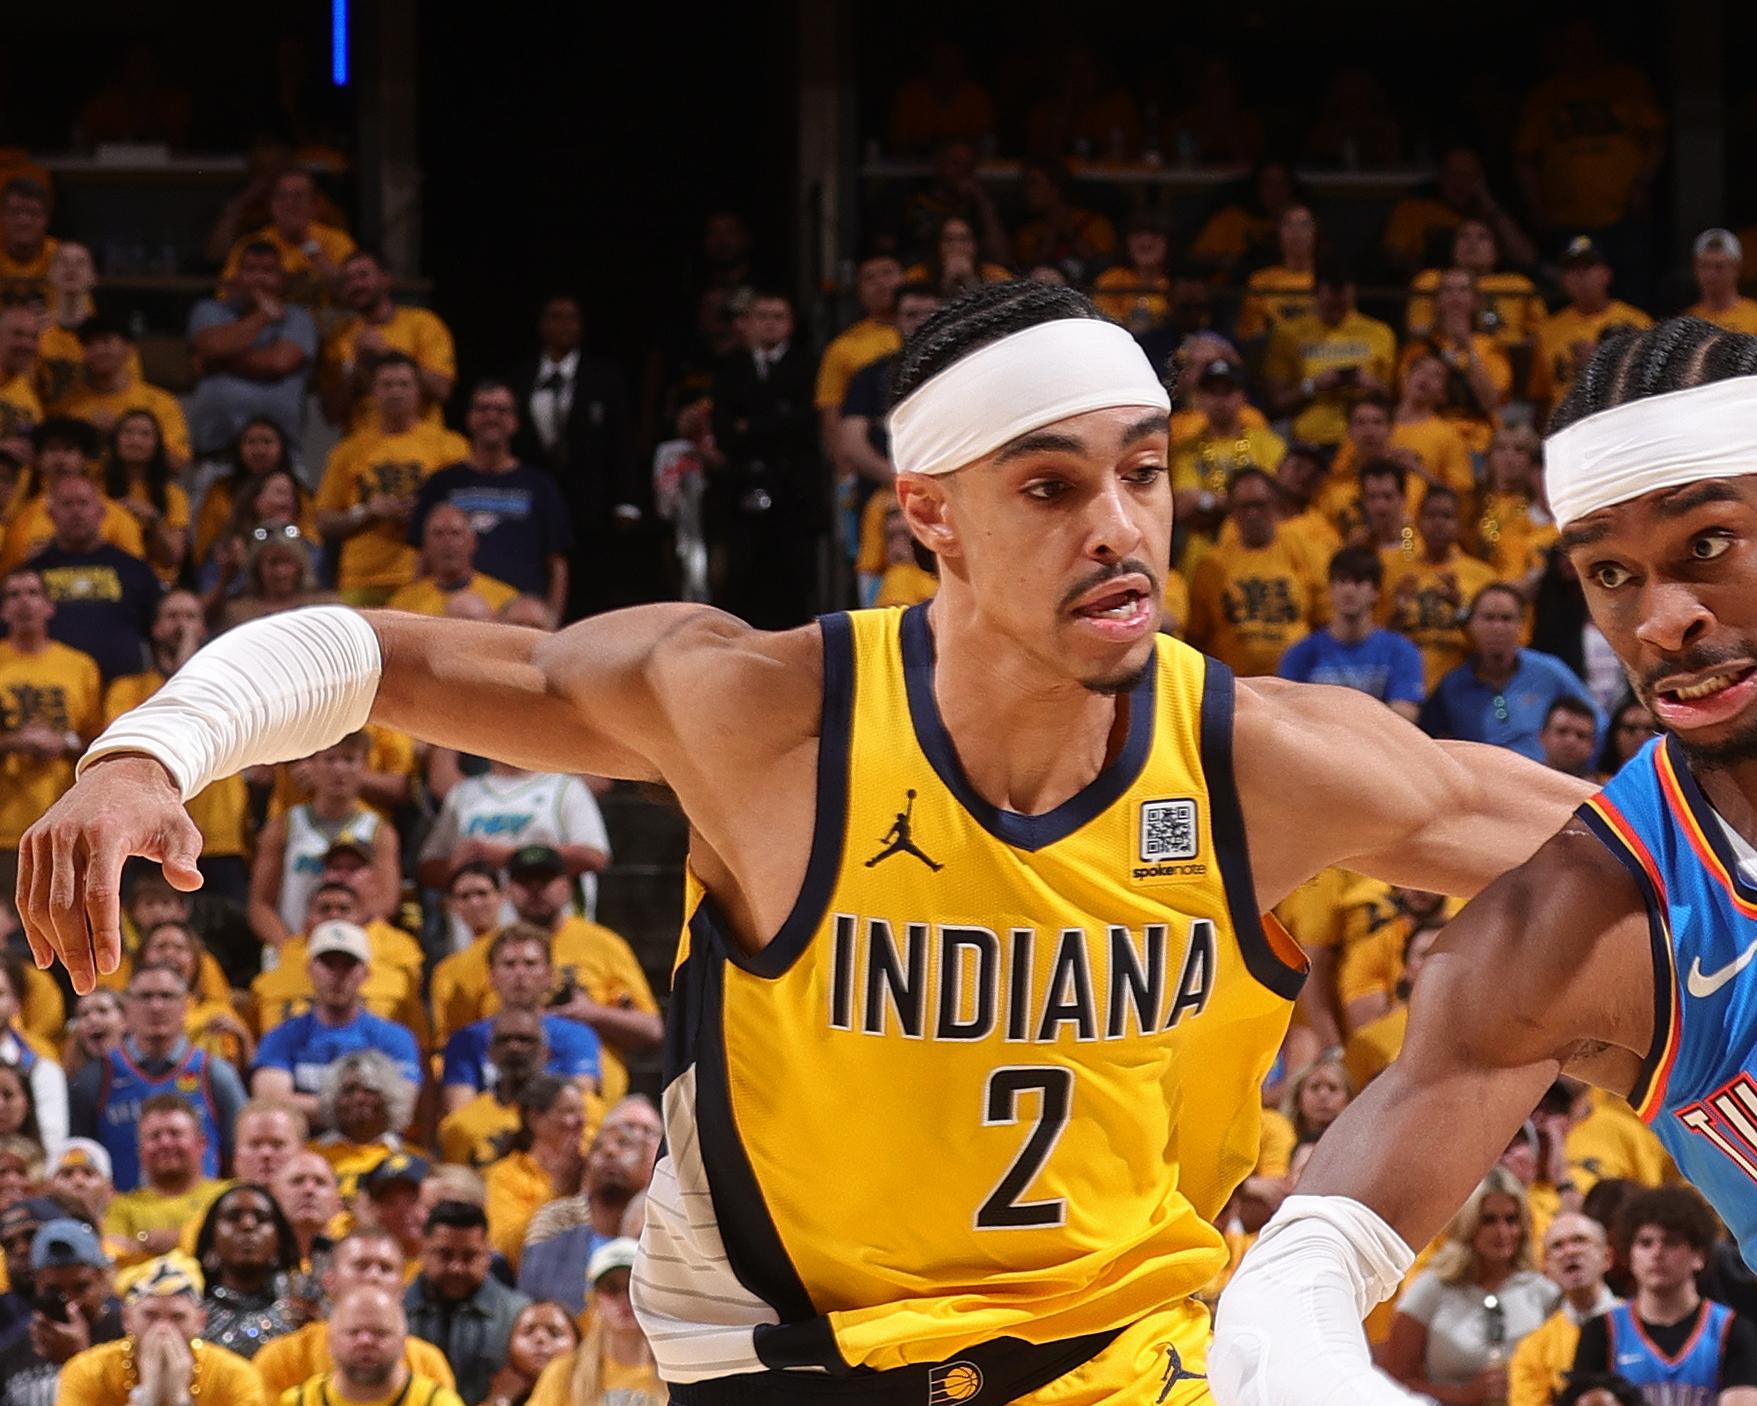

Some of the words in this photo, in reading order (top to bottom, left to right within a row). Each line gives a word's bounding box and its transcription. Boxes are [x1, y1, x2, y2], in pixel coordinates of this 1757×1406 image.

[1132, 865, 1207, 881] spokenote
[828, 913, 1217, 1043] INDIANA
[971, 1064, 1076, 1232] 2
